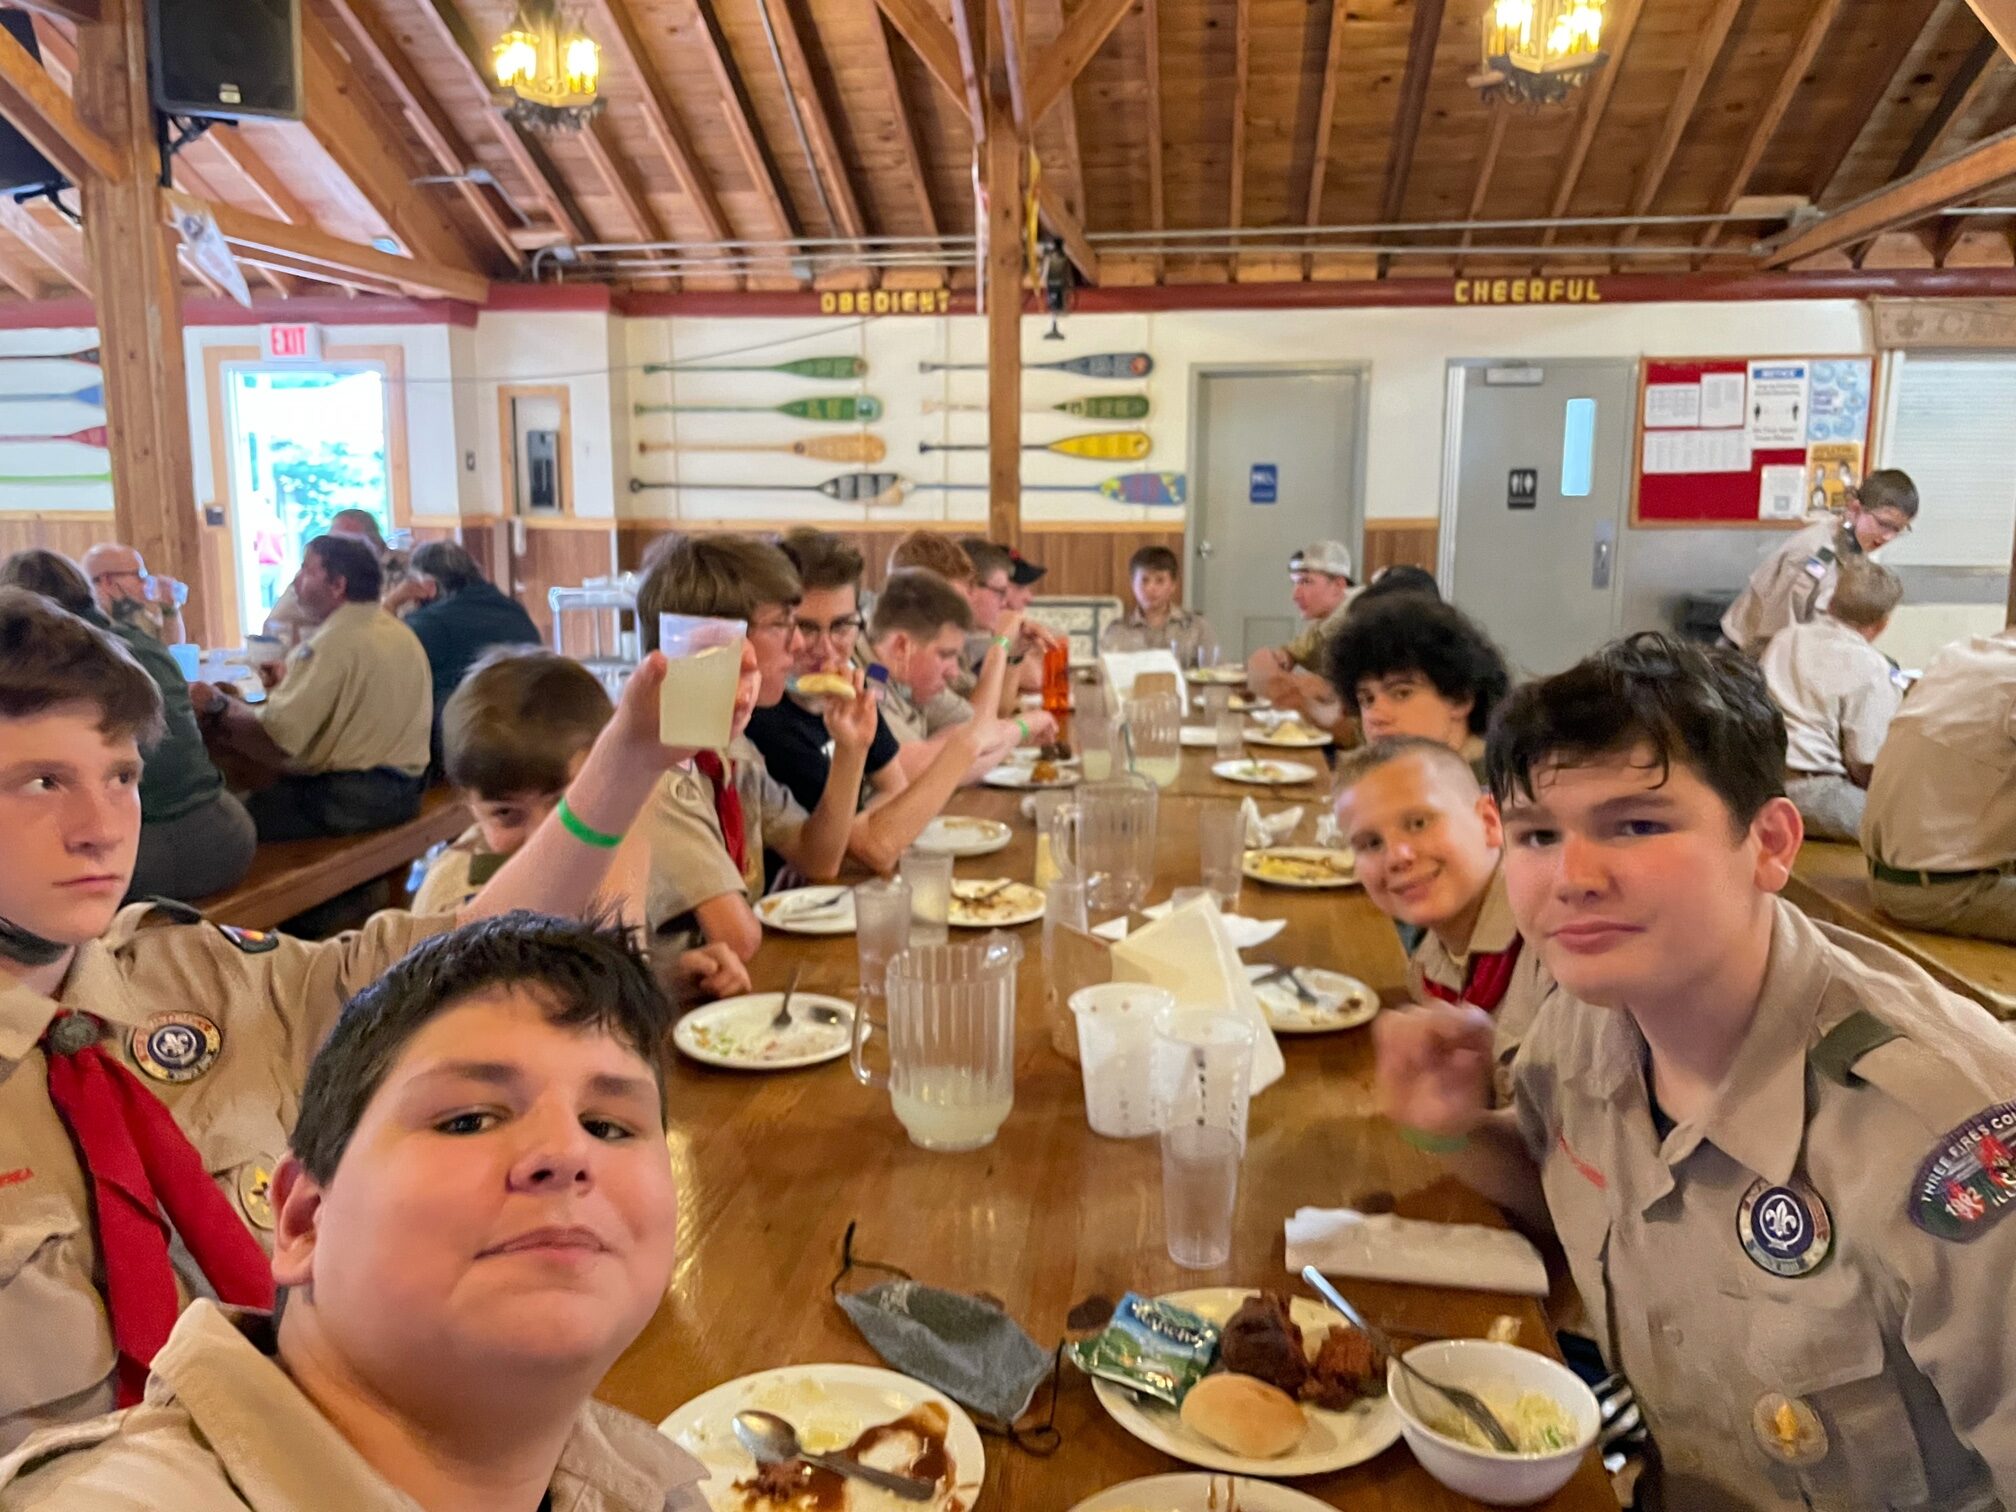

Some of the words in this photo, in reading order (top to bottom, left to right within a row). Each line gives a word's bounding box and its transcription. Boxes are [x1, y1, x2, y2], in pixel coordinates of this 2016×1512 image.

[820, 290, 951, 313] OBEDIENT
[1454, 279, 1601, 303] CHEERFUL
[271, 325, 305, 355] EXIT
[1921, 1156, 1951, 1202] THREE
[1948, 1123, 1990, 1157] FIRES
